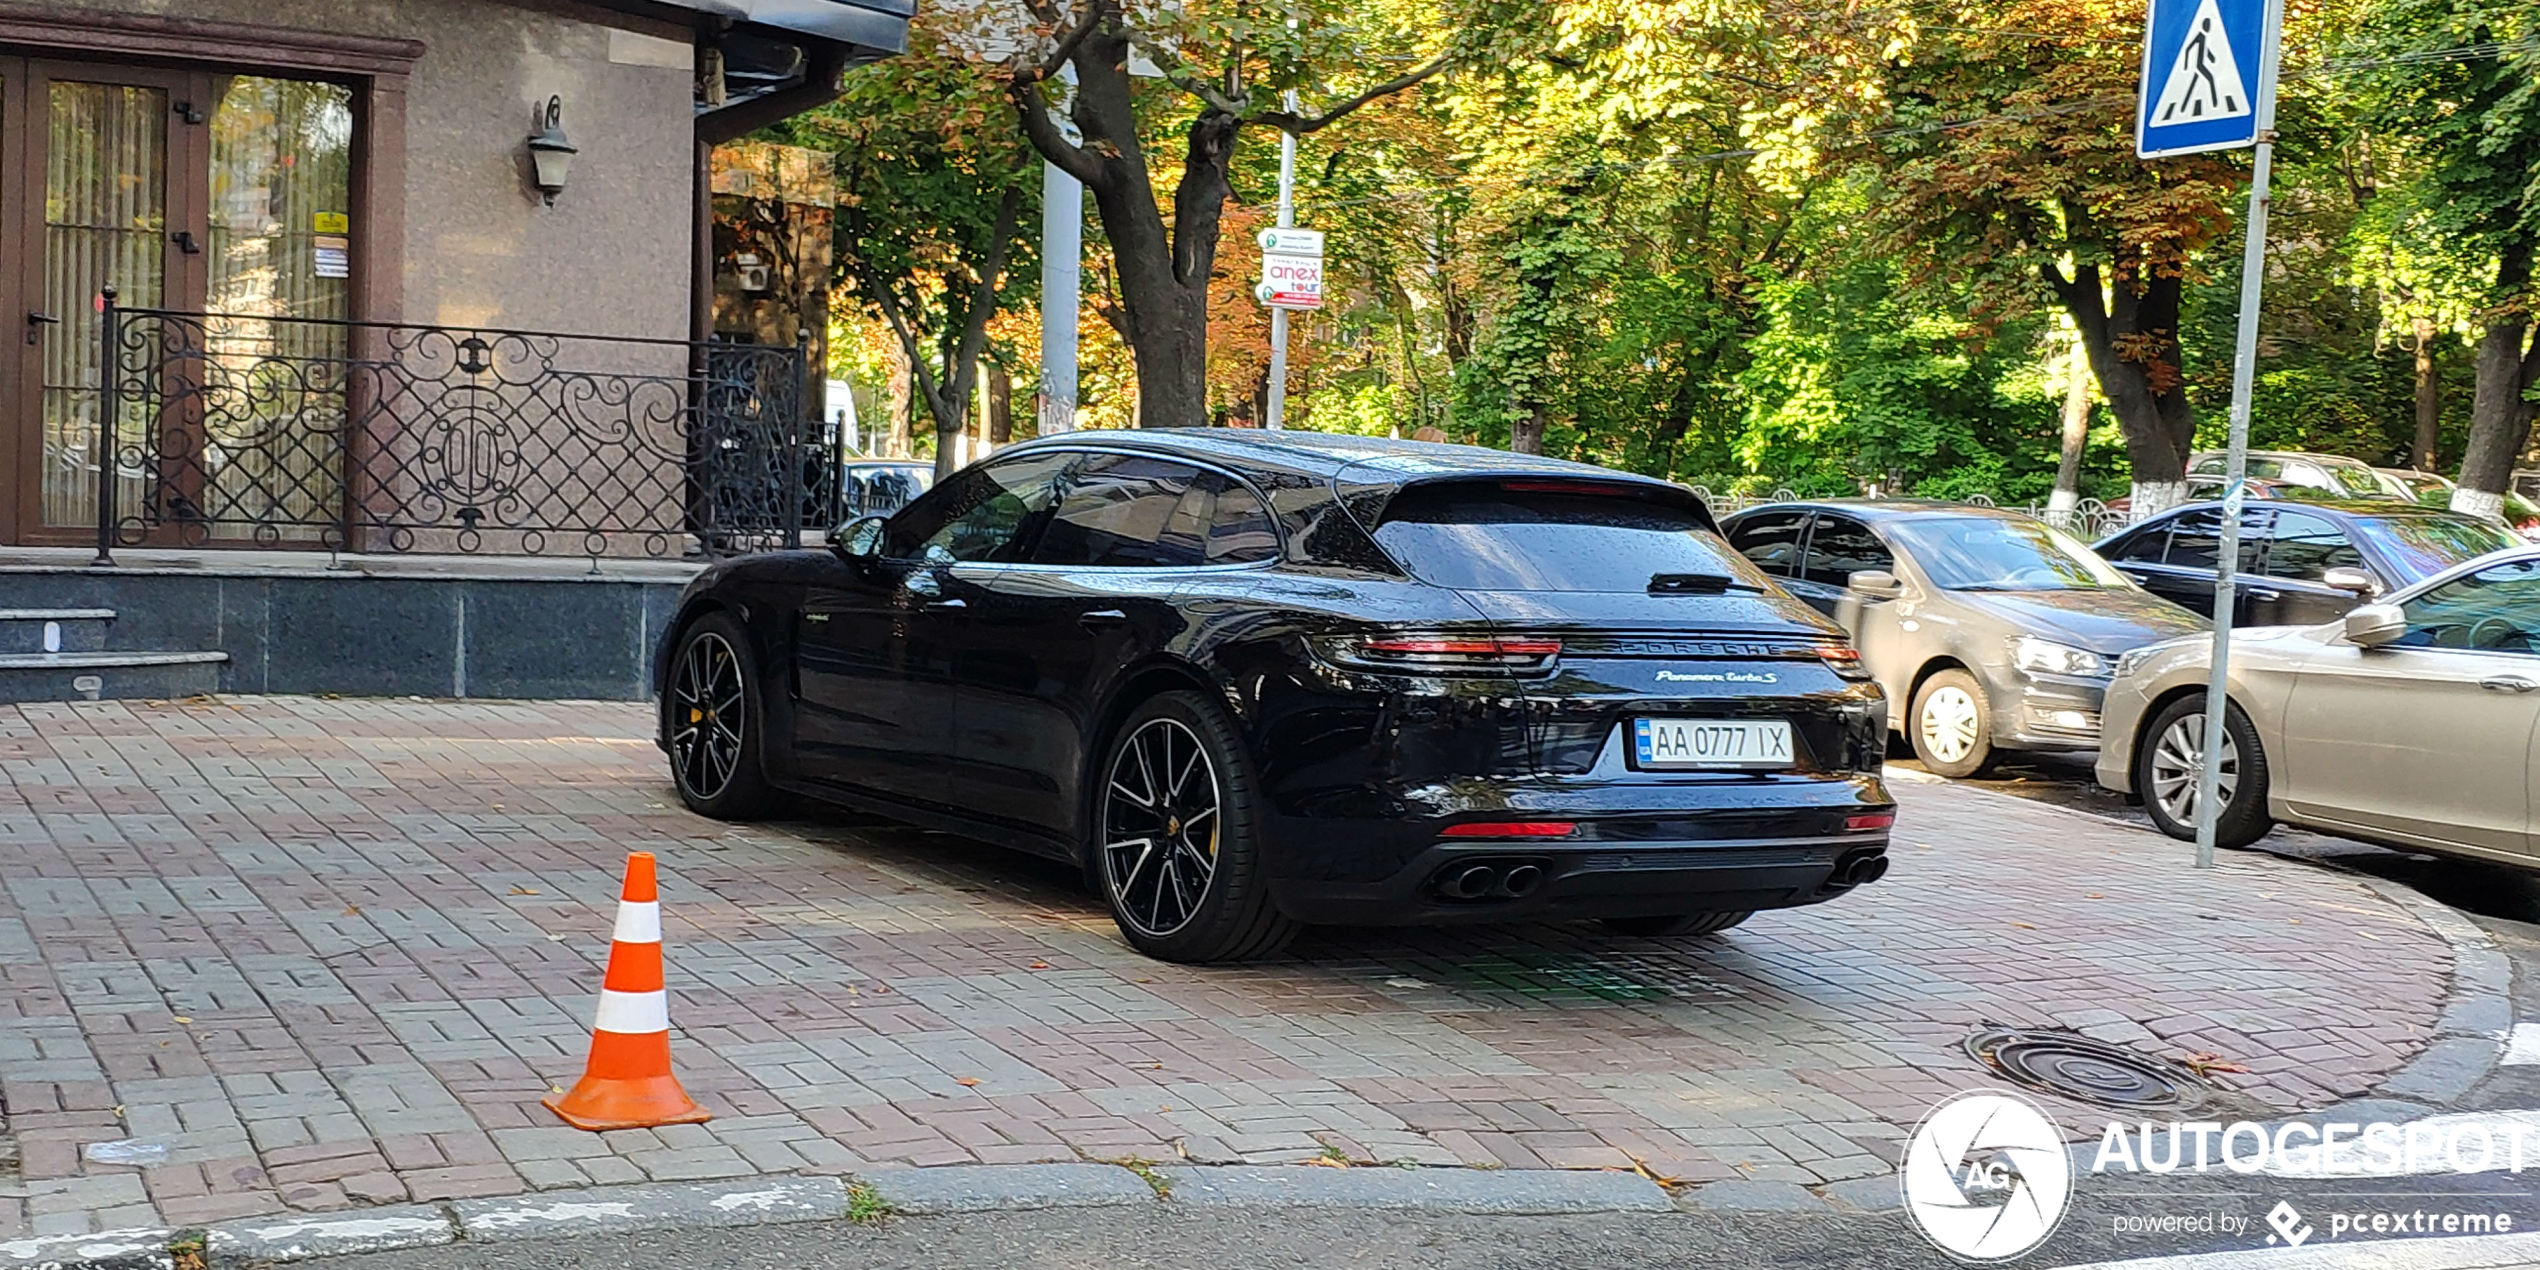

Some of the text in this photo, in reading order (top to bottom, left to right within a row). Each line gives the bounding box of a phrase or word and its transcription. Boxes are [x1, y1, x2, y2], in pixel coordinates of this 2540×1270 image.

[1270, 266, 1319, 281] anex
[1290, 282, 1319, 292] tour
[1620, 641, 1783, 656] PORSCHE
[1655, 670, 1724, 682] Panamera
[1761, 673, 1777, 683] S
[1655, 726, 1787, 757] AA 0777 IX
